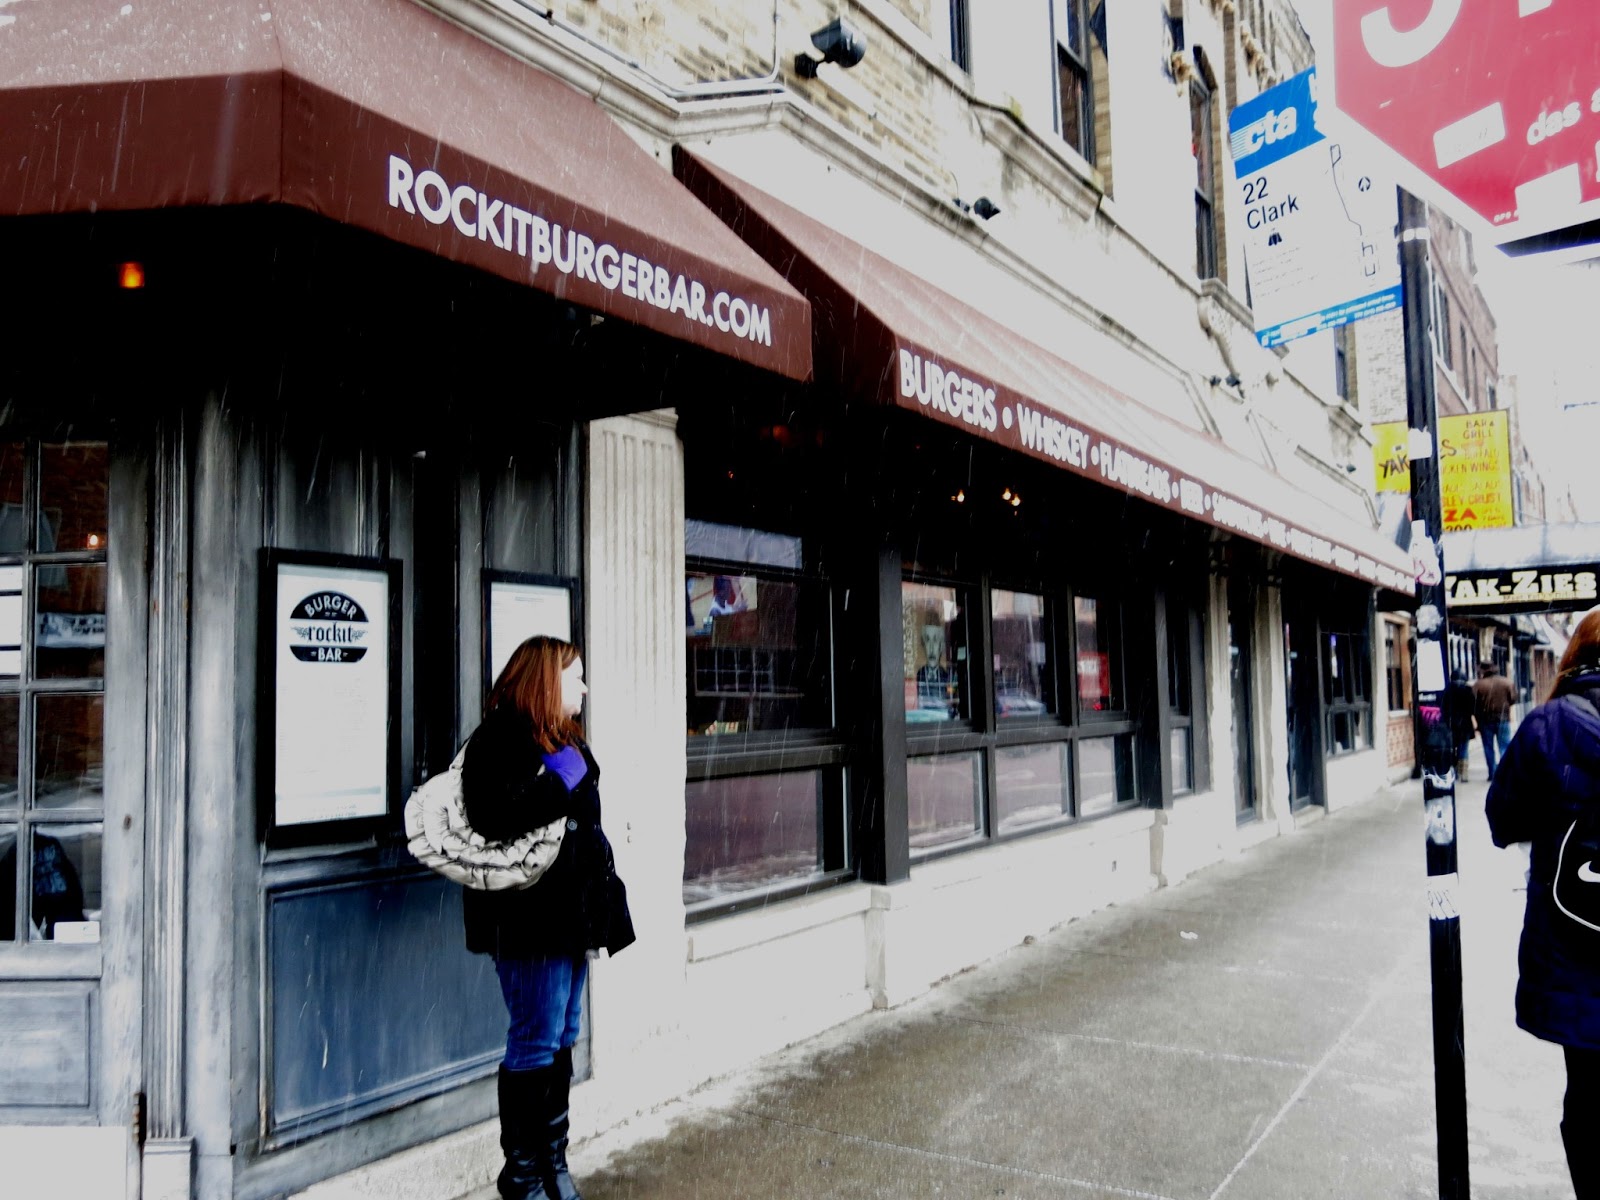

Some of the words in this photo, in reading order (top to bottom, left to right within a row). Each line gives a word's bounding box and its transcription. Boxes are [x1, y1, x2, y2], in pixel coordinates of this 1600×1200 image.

[1244, 106, 1298, 152] cta
[1243, 177, 1269, 206] 22
[1246, 194, 1300, 230] Clark
[388, 154, 772, 347] ROCKITBURGERBAR.COM
[900, 348, 997, 433] BURGERS
[1016, 403, 1090, 470] WHISKEY
[304, 595, 358, 620] BURGER
[308, 621, 352, 643] rockit
[318, 647, 342, 662] BAR
